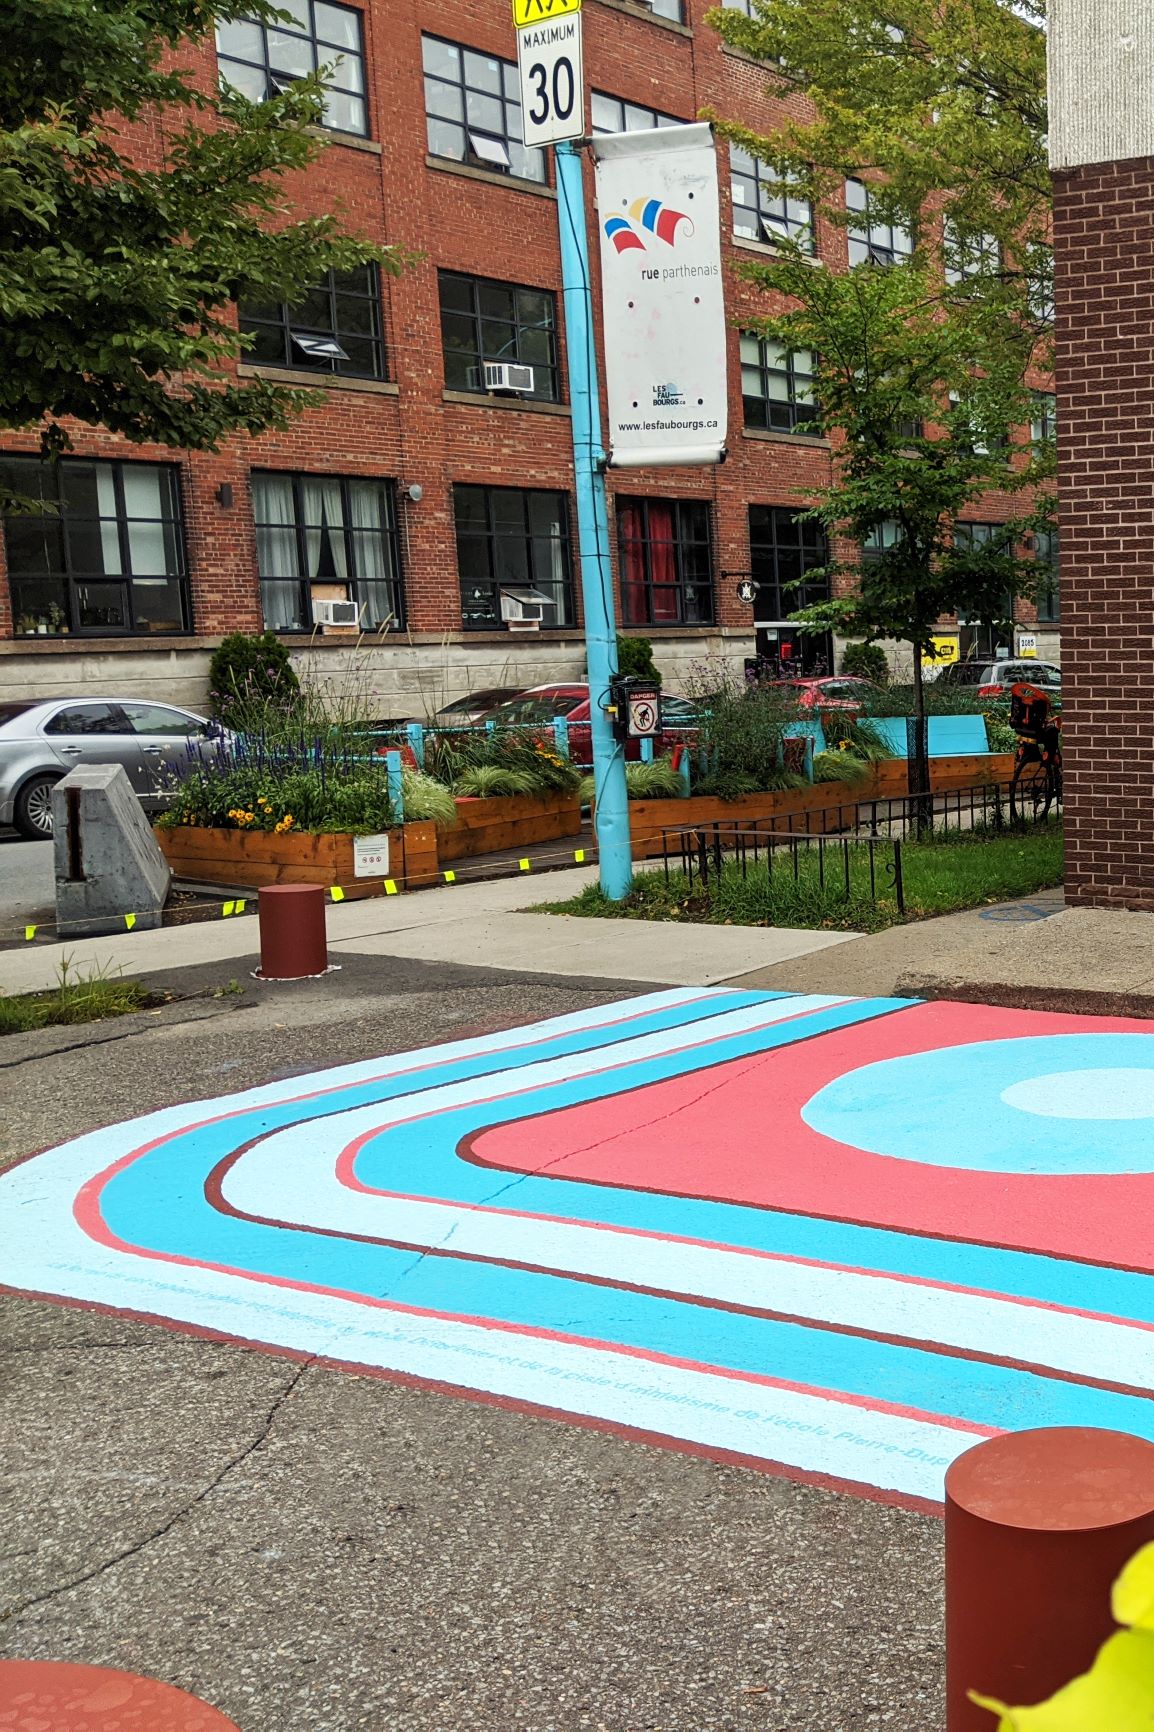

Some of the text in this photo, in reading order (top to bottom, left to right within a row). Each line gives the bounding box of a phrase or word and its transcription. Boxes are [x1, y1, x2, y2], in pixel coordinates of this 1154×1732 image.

[524, 23, 575, 50] MAXIMUM
[528, 56, 575, 125] 30
[641, 262, 719, 282] rue parthenais
[652, 385, 667, 393] LES
[618, 420, 718, 431] www.lesfaubourgs.ca
[518, 1358, 543, 1371] de
[733, 1409, 761, 1421] de
